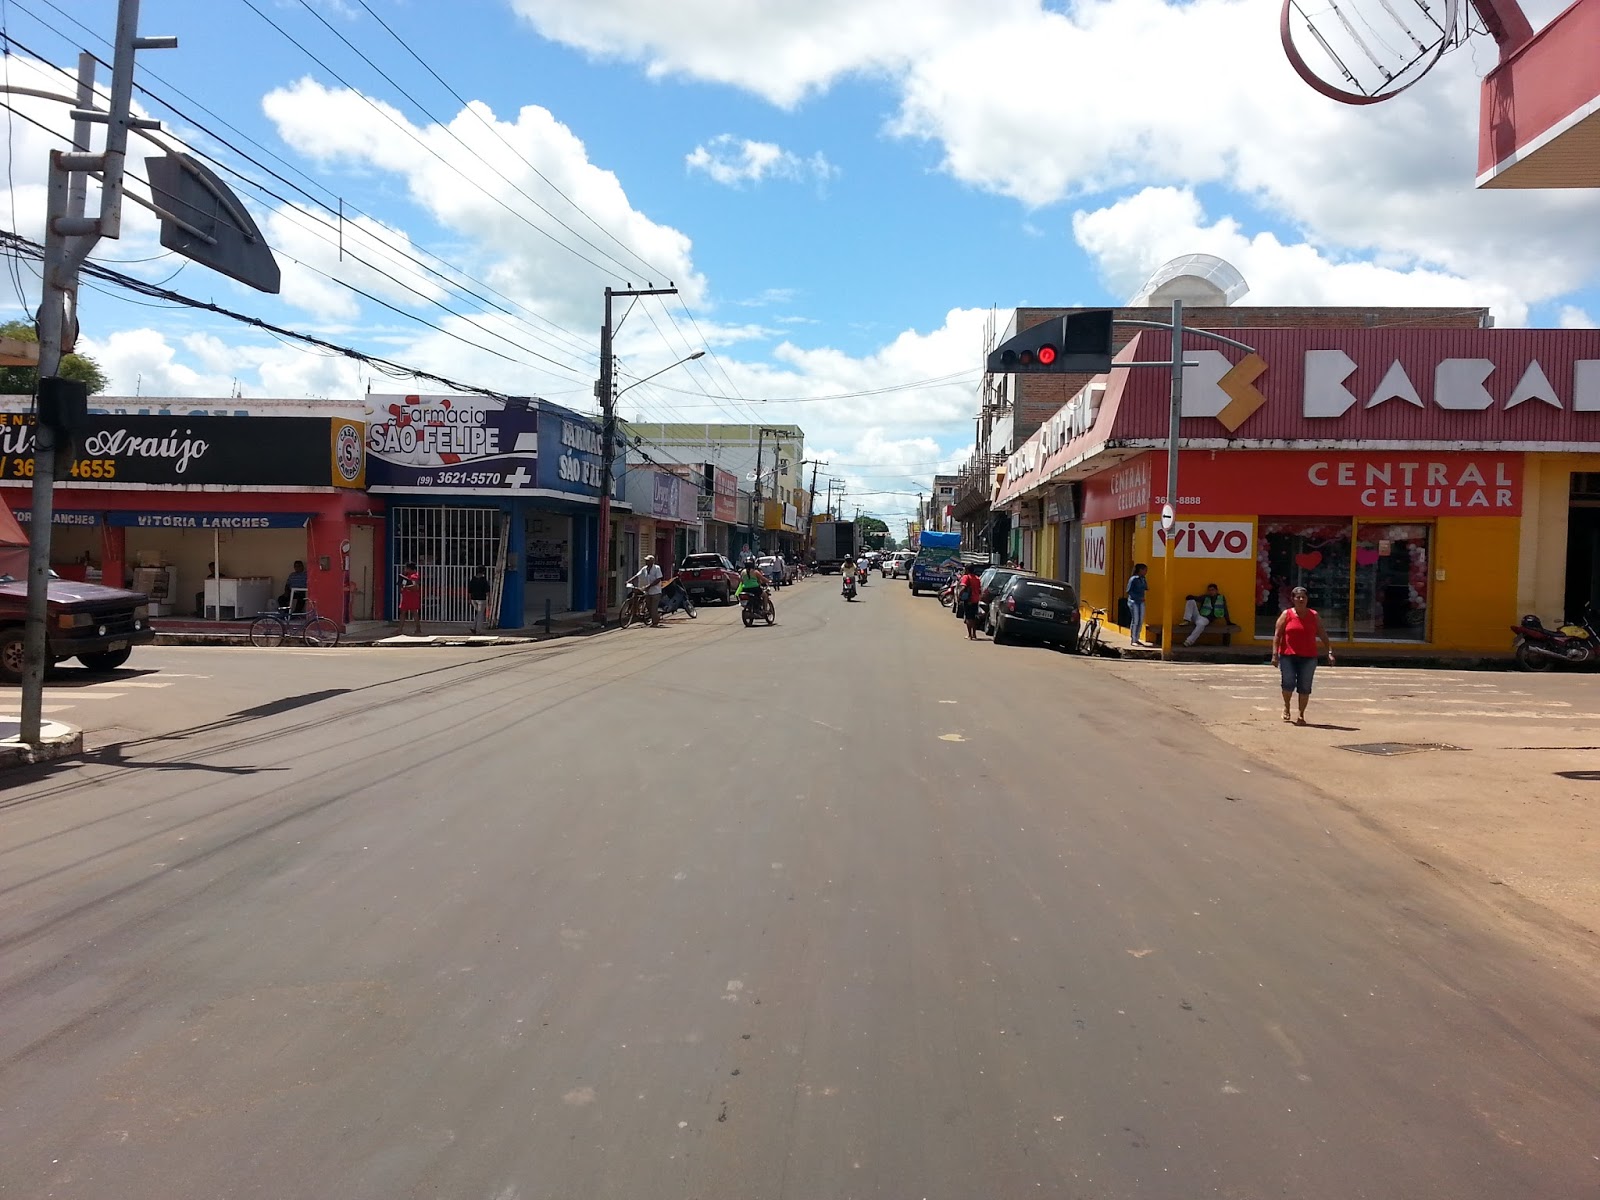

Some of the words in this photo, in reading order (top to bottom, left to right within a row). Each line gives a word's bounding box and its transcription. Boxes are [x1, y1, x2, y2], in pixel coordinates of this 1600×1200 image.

[400, 400, 487, 424] Farmácia
[370, 418, 417, 453] SÃO
[423, 425, 500, 454] FELIPE
[562, 420, 617, 458] FARMAC
[85, 429, 209, 473] Araújo
[417, 476, 433, 486] (99)
[437, 472, 501, 485] 3621-5570
[1111, 462, 1147, 495] CENTRAL
[1307, 462, 1512, 486] CENTRAL
[1118, 488, 1146, 510] CELULAR
[1360, 488, 1513, 507] CELULAR
[51, 513, 95, 525] ANCHES
[202, 517, 270, 528] LANCHES
[1084, 528, 1105, 571] vivo
[1156, 522, 1248, 554] vivo
